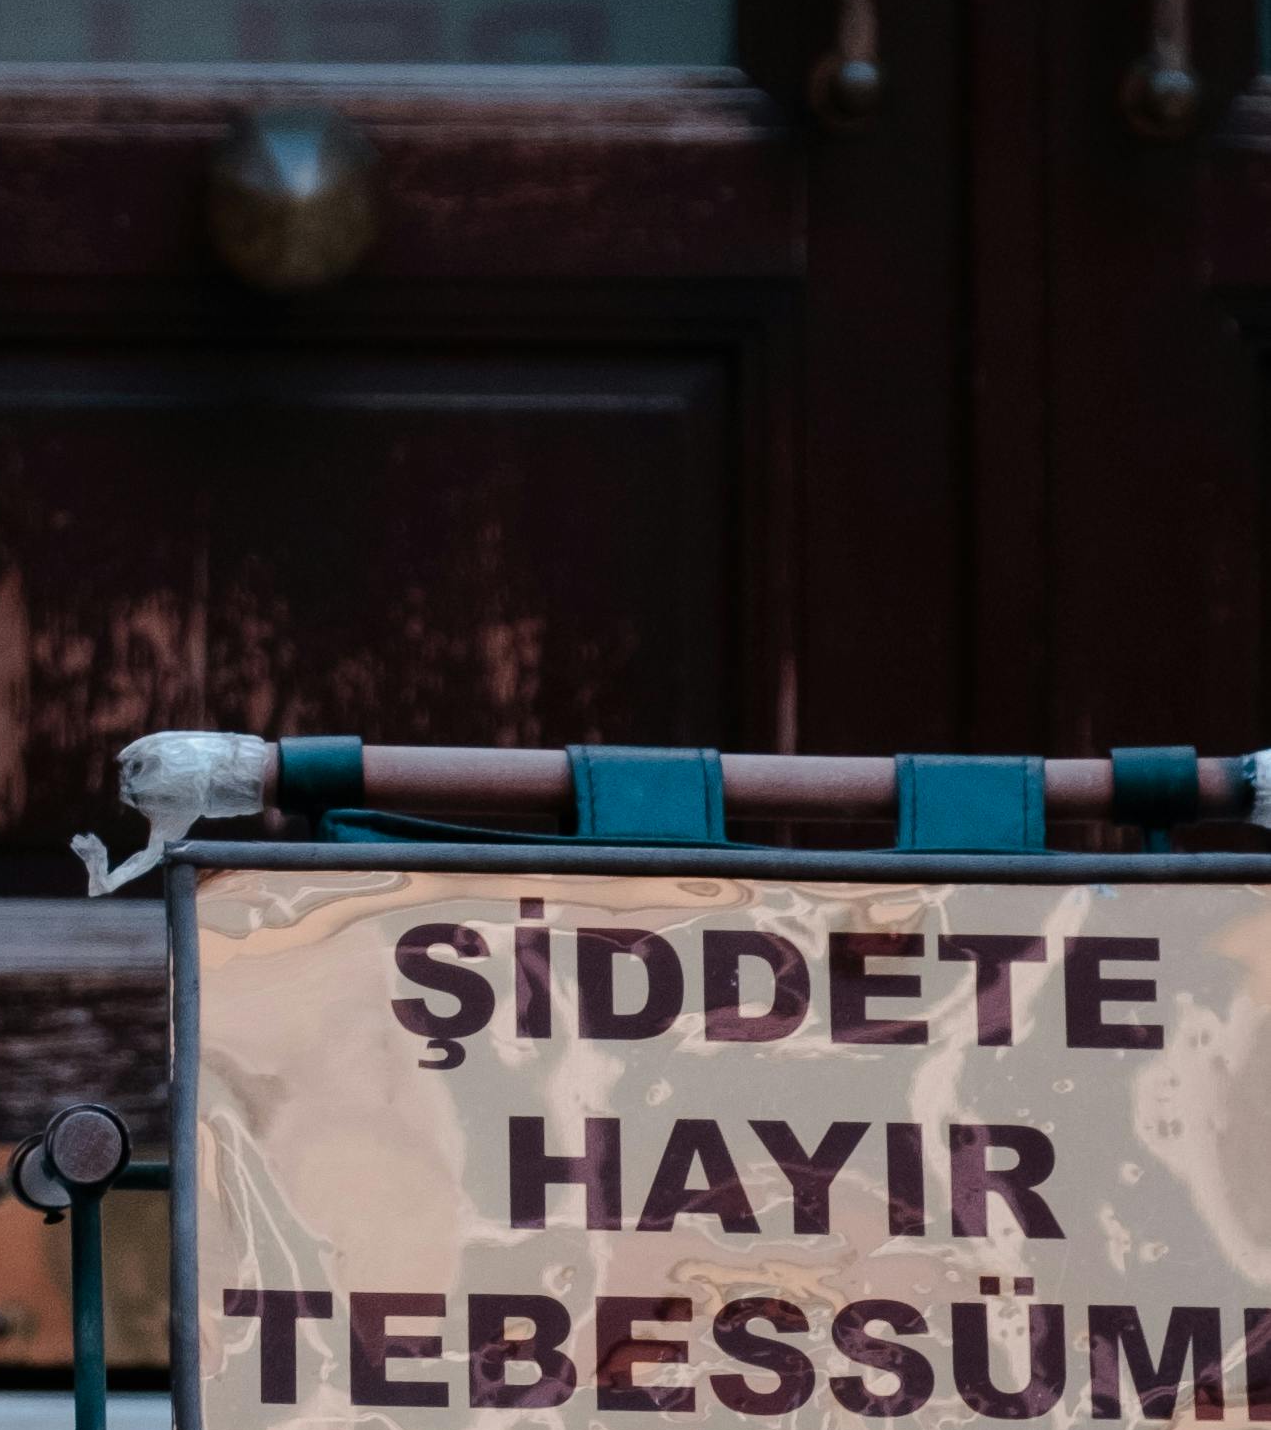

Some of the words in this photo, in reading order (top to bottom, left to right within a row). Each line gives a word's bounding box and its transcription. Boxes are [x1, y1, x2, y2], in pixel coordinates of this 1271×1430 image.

[389, 896, 1166, 1071] ŞİDDETE
[507, 1115, 1067, 1241] HAYIR
[222, 1276, 1271, 1423] TEBESSÜM
